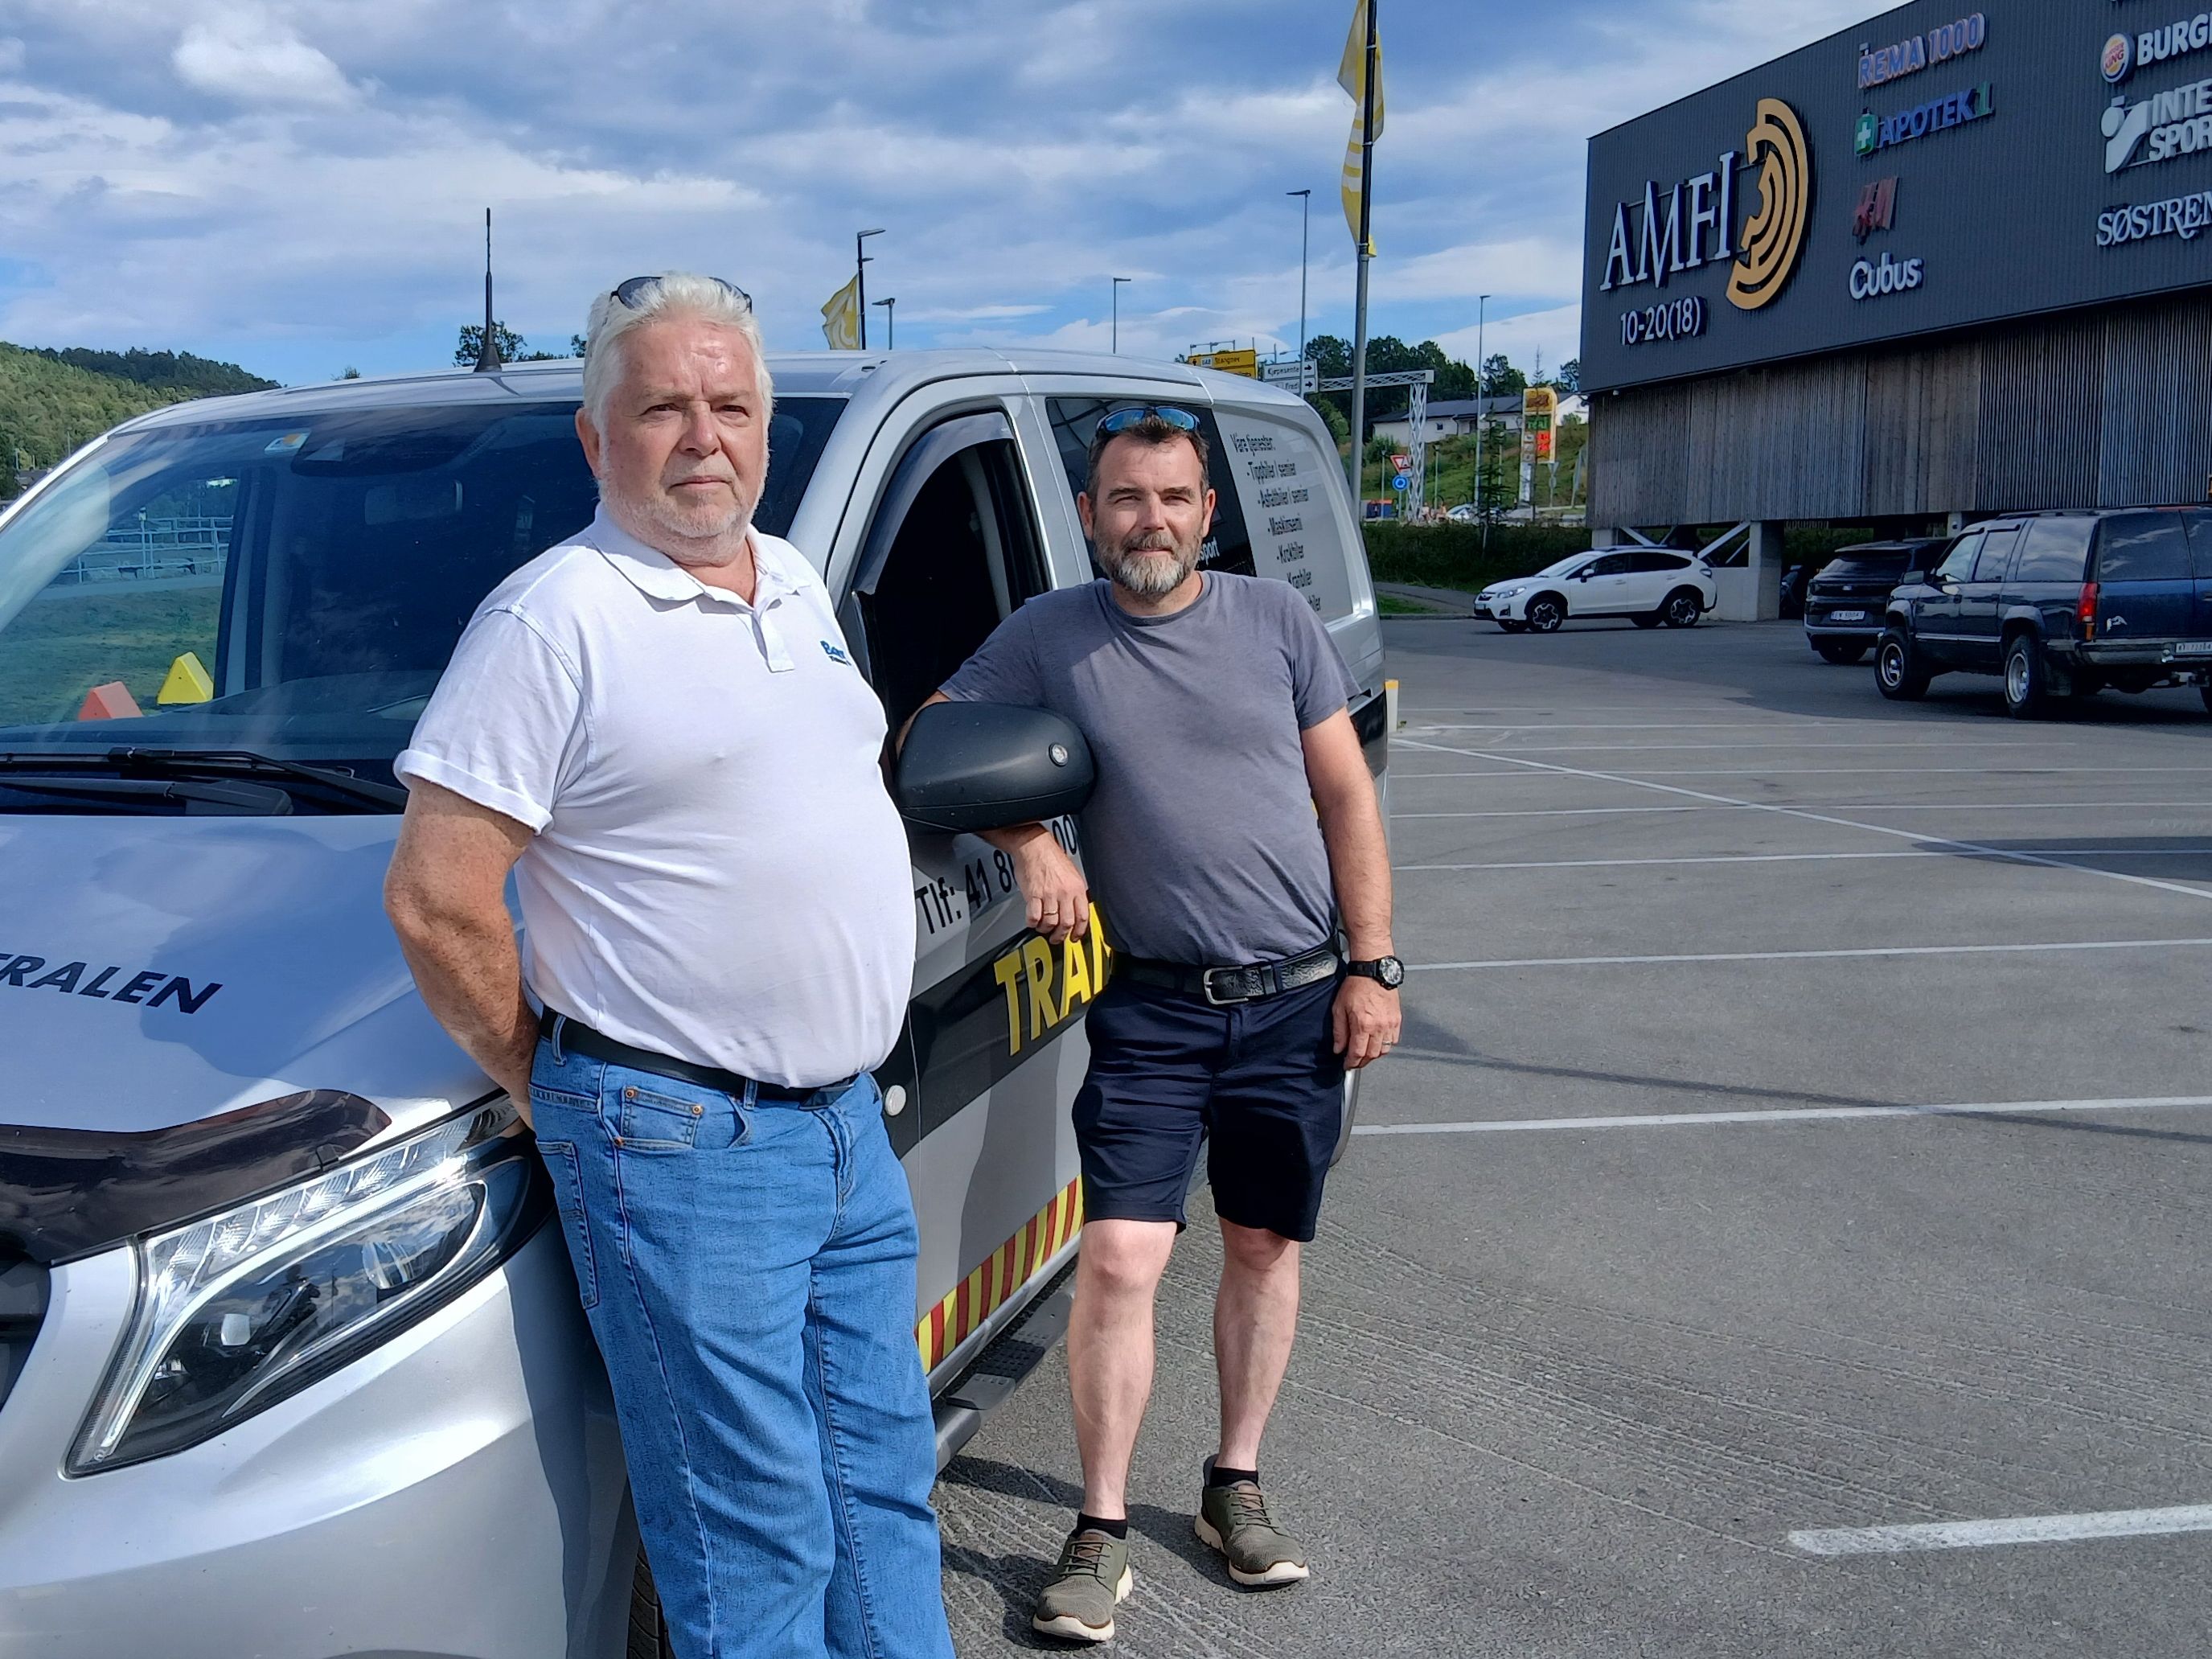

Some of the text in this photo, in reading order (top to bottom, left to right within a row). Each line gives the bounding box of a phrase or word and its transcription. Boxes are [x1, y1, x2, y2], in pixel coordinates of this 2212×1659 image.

[1859, 12, 1986, 88] REMA 1000
[2136, 11, 2212, 66] BURG
[1599, 150, 1739, 291] AMFI
[1849, 252, 1923, 300] Cubus
[1620, 296, 1704, 346] 10-20(18)
[965, 858, 993, 909] 41
[994, 849, 1017, 893] 8
